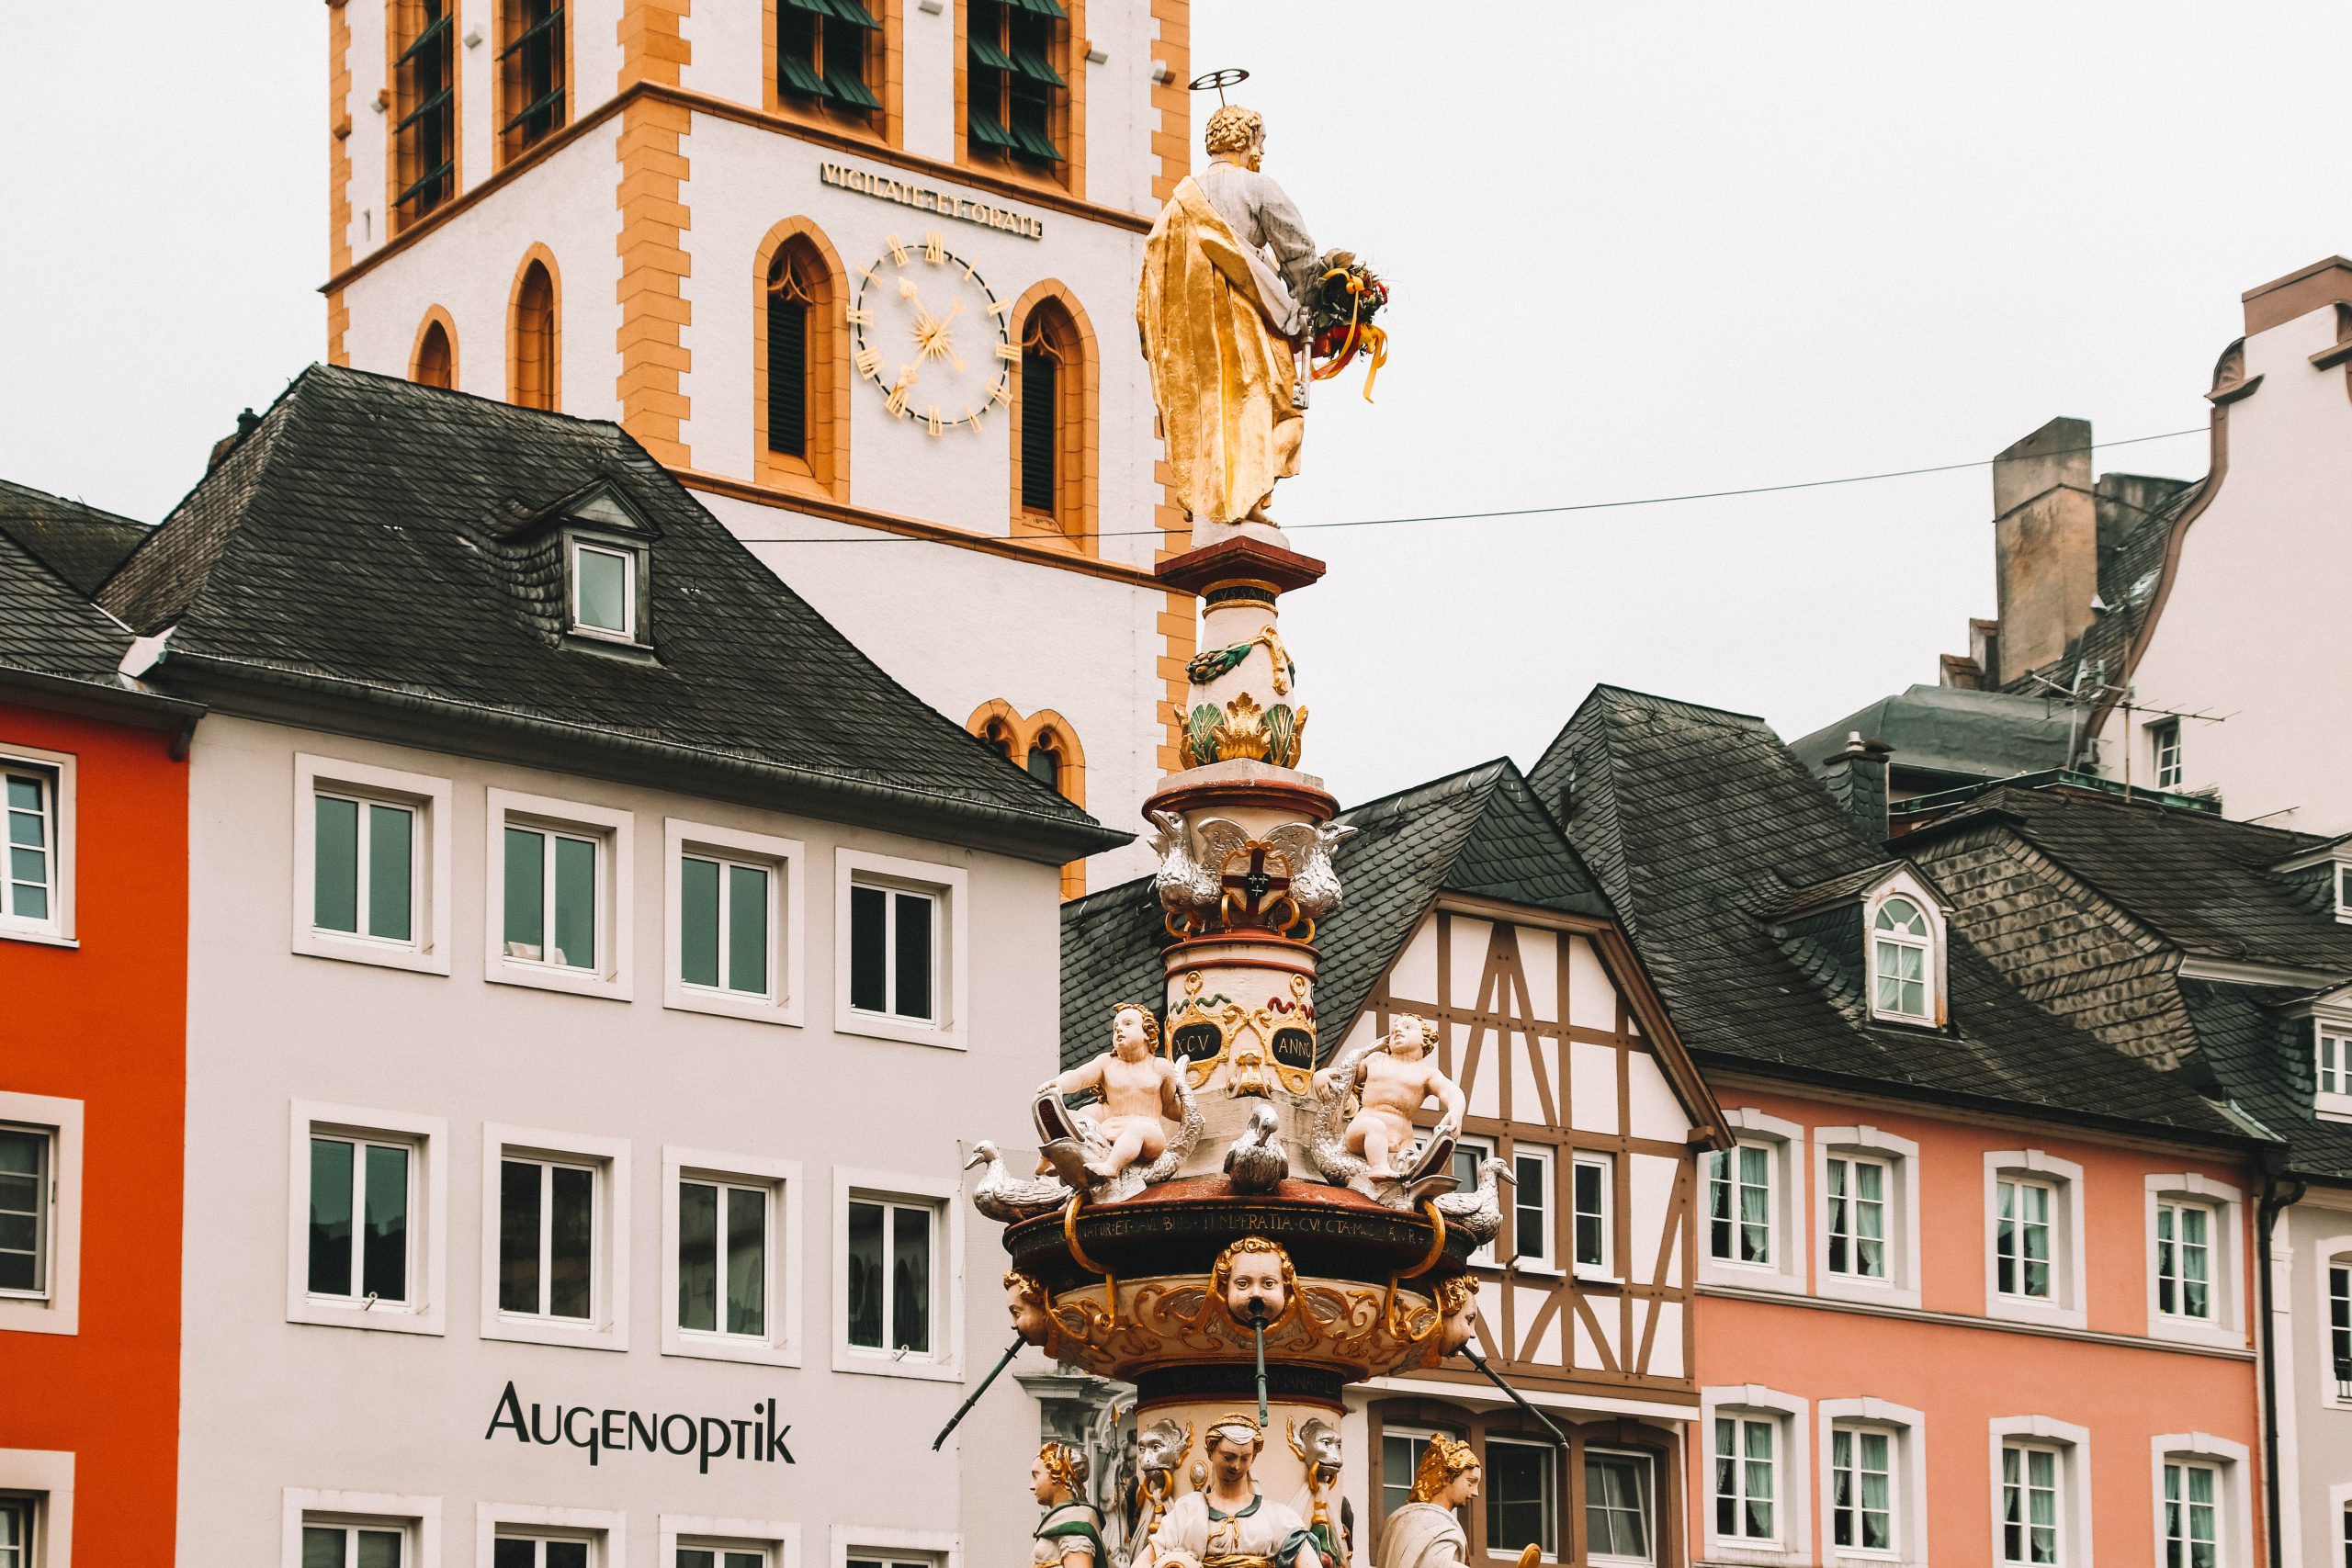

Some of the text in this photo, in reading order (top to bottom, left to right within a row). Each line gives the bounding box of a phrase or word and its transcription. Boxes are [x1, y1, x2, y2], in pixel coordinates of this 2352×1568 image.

[822, 162, 1042, 240] VIGILATE ET ORATE
[1175, 1034, 1210, 1055] XCV
